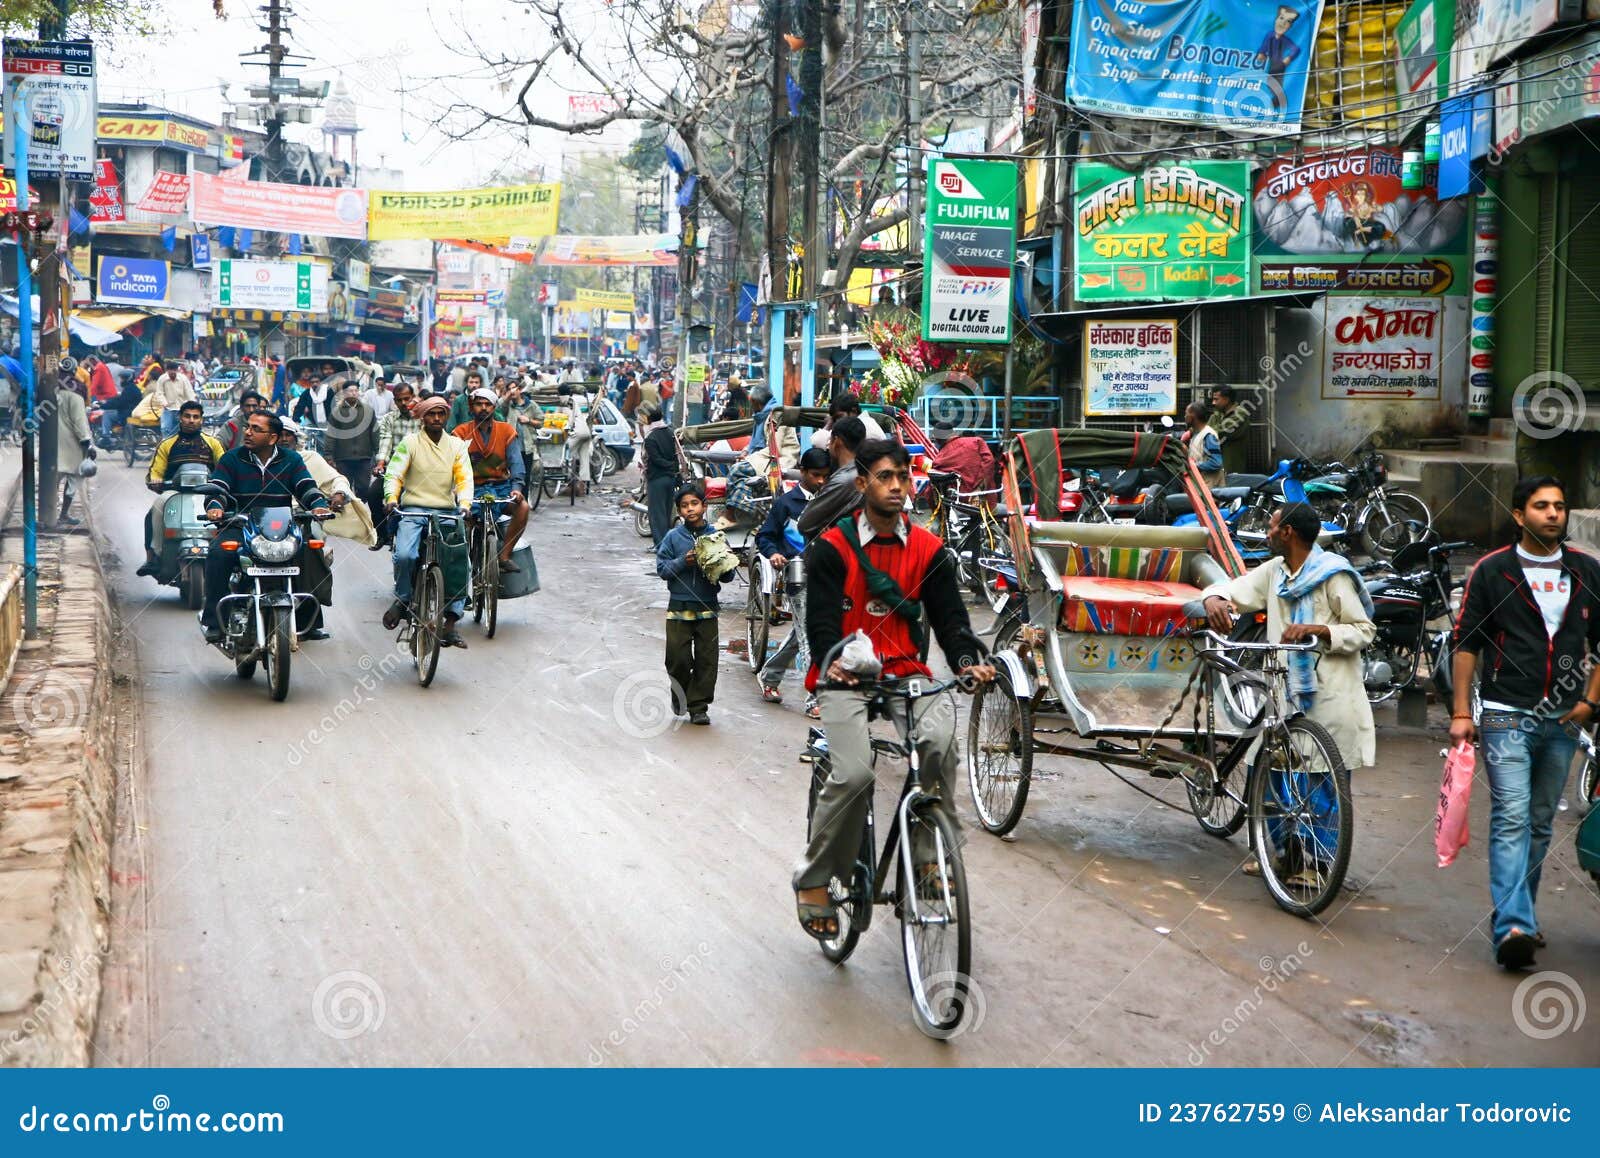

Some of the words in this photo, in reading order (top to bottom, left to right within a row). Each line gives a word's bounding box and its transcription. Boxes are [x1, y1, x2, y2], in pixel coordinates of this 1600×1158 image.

[1113, 0, 1147, 15] Your
[1126, 21, 1162, 42] Stop
[1087, 38, 1160, 61] Financial
[1167, 33, 1269, 72] Bonanza
[1100, 62, 1139, 83] Shop
[1161, 68, 1212, 85] Portfolio
[1217, 75, 1262, 92] Limited
[97, 122, 159, 135] GAM
[1442, 126, 1467, 160] NOKIA
[938, 203, 1010, 220] FUJIFILM
[1078, 176, 1137, 236] लाइव
[1141, 166, 1245, 233] डिजिटल
[940, 231, 977, 241] IMAGE
[1093, 233, 1168, 259] कलर
[1178, 221, 1231, 258] लैब
[956, 247, 1004, 258] SERVICE
[132, 273, 157, 283] TATA
[1163, 266, 1207, 281] Kodak
[1348, 269, 1401, 287] कलर
[1402, 264, 1436, 287] लैब
[111, 279, 157, 293] indicom
[949, 308, 990, 323] LIVE
[1335, 303, 1439, 345] कोमल
[932, 323, 960, 333] DIGITAL
[962, 324, 990, 334] COLOUR
[992, 325, 1006, 335] LAB
[1090, 323, 1136, 345] संस्कार
